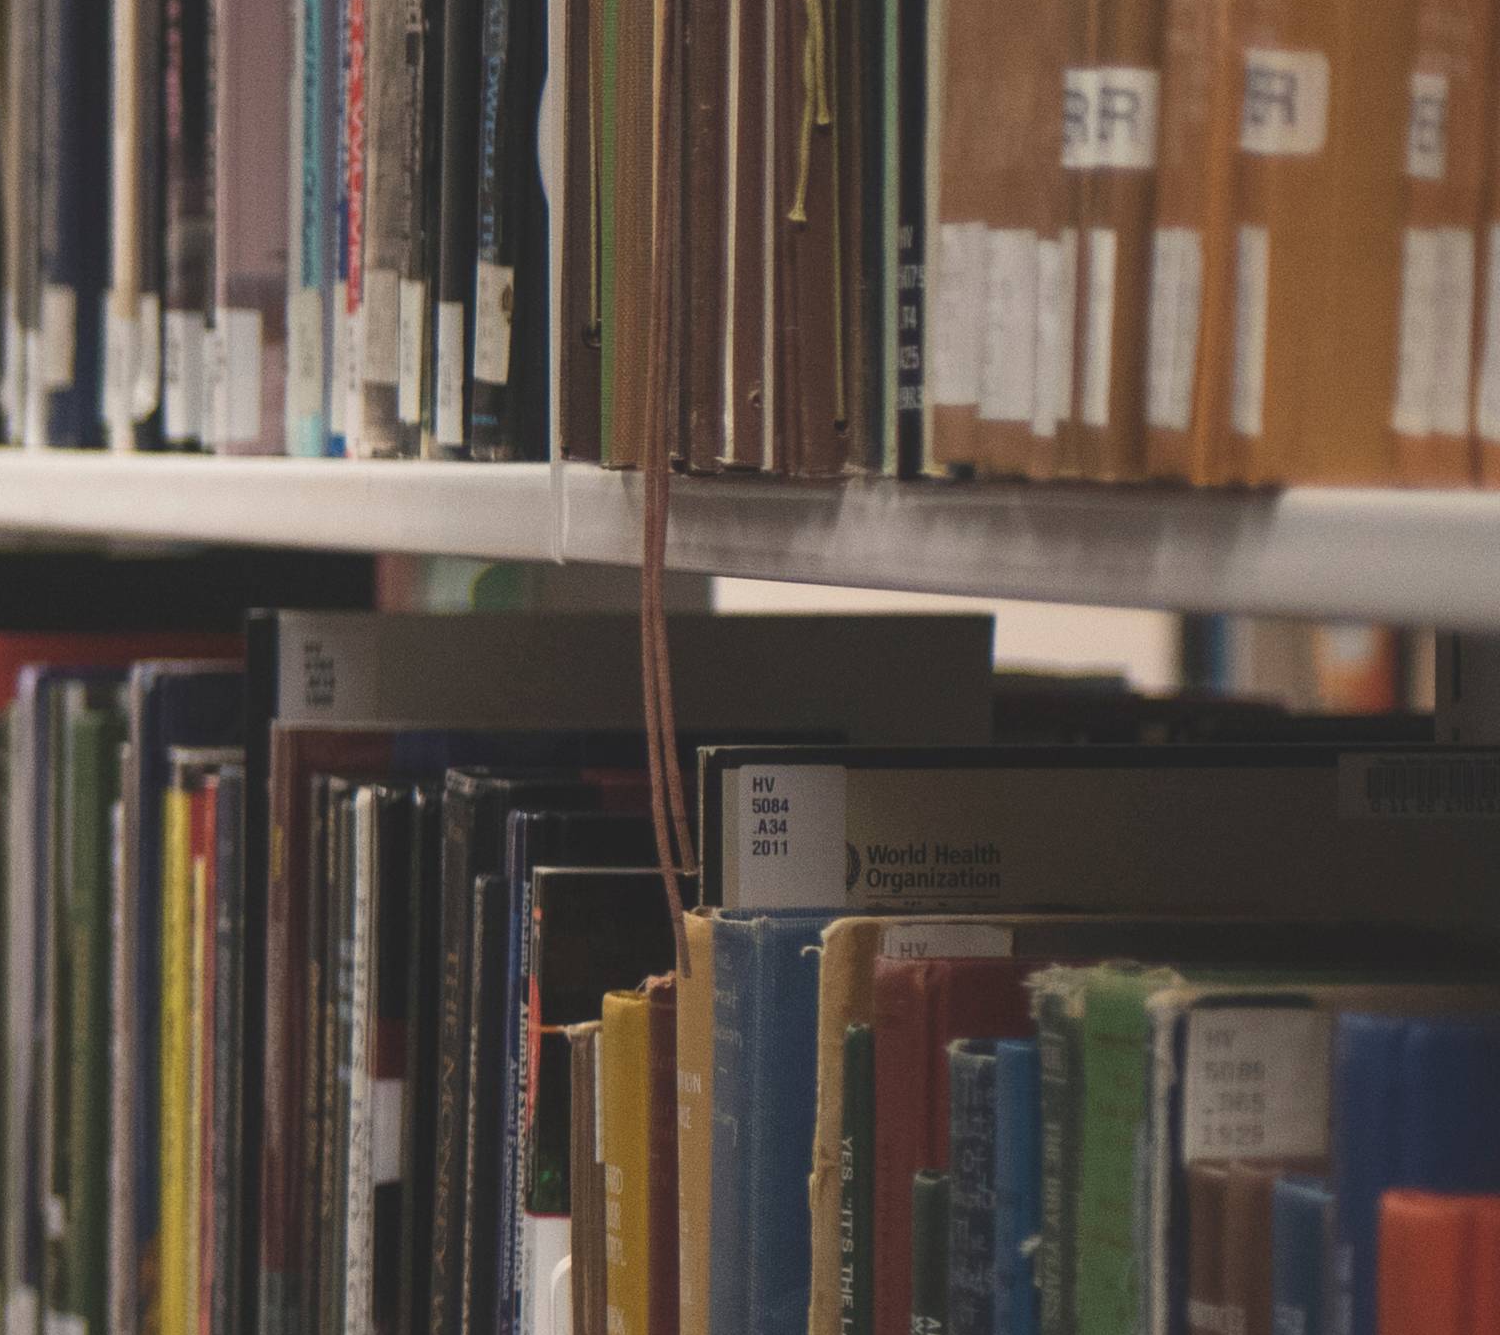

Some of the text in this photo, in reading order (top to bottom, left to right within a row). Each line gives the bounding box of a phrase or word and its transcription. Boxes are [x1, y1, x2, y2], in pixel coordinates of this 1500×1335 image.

[752, 777, 775, 793] HV
[752, 798, 790, 814] 5084
[753, 819, 788, 835] .A34
[752, 840, 790, 857] 2011
[867, 842, 1001, 865] World Health
[866, 867, 1001, 894] Organization
[900, 942, 929, 959] HV
[443, 944, 461, 1040] THE
[517, 999, 529, 1086] Animal
[506, 1055, 518, 1130] Animal
[436, 1055, 455, 1274] MONKEY
[841, 1135, 855, 1186] YES,
[841, 1264, 856, 1309] THE
